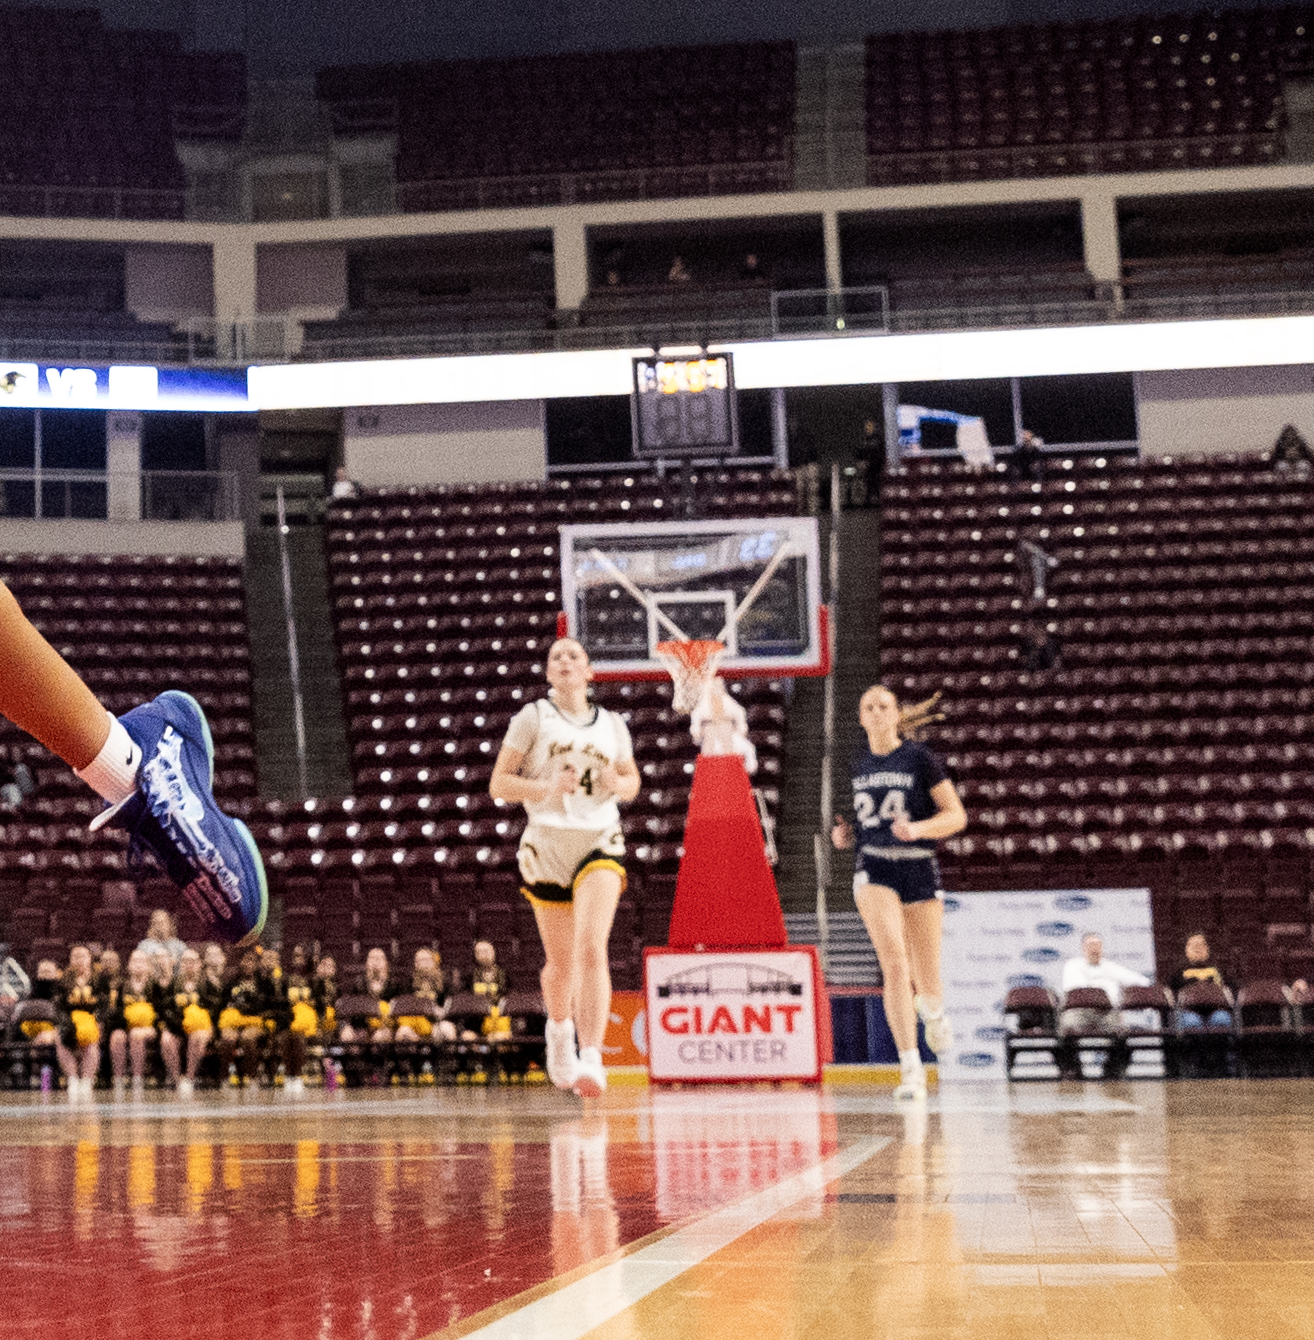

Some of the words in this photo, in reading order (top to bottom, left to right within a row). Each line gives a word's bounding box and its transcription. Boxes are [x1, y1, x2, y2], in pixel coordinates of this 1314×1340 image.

[853, 789, 908, 830] 24
[660, 1004, 802, 1035] GIANT
[678, 1039, 787, 1064] CENTER
